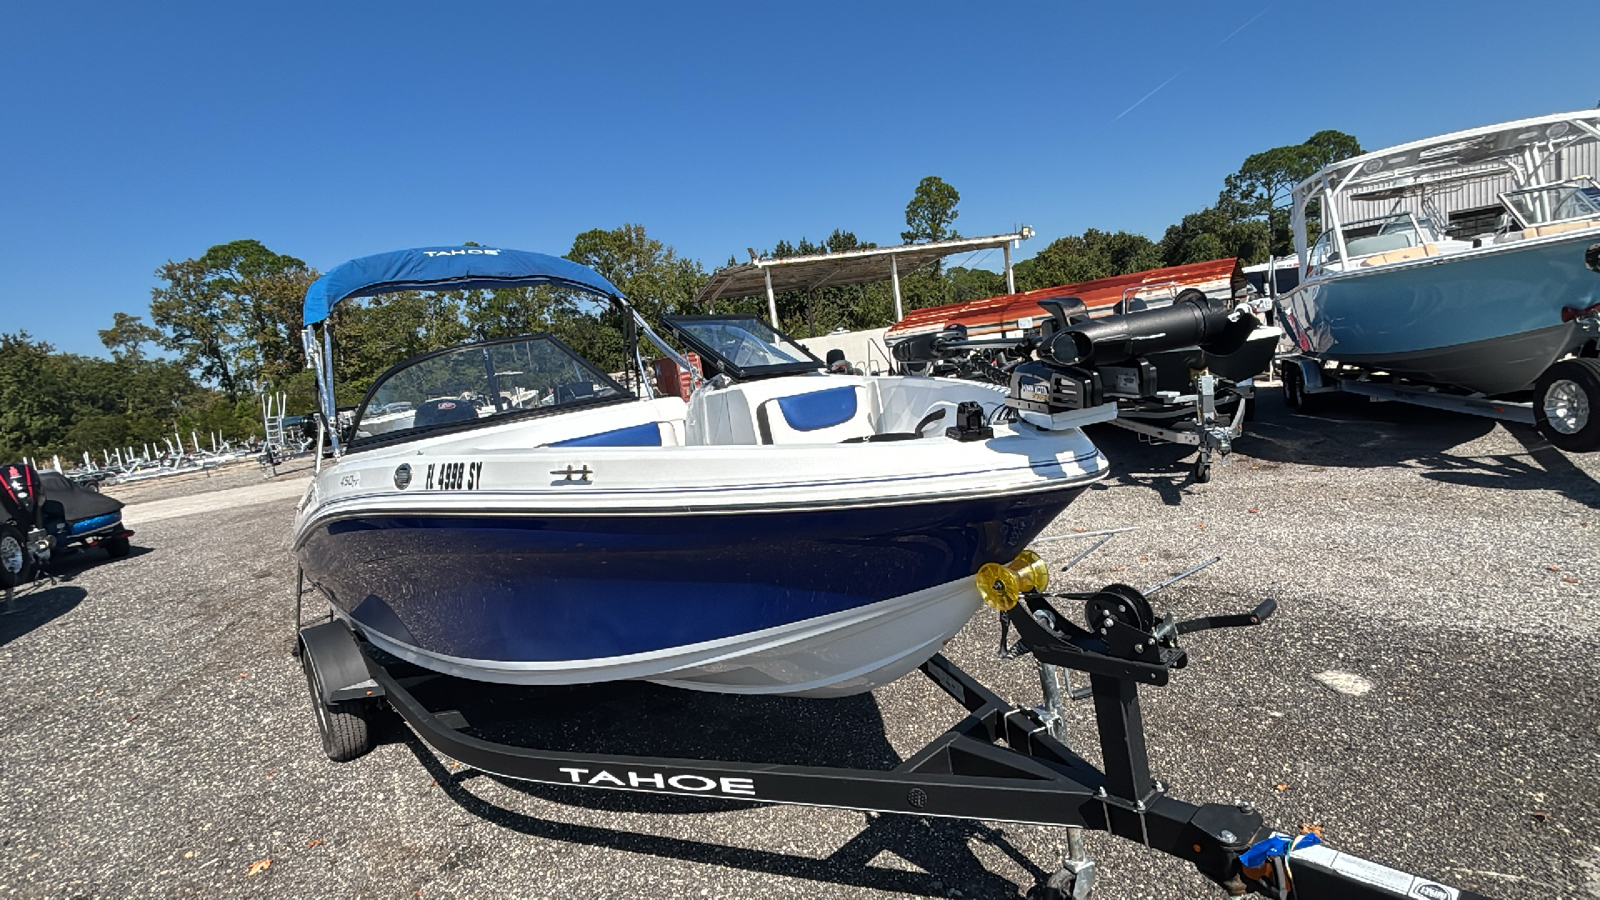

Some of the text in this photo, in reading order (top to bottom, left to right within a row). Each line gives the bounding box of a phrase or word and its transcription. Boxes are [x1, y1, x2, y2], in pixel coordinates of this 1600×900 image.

[423, 249, 501, 257] TAHOE
[425, 462, 483, 490] FL 4998 SY
[559, 767, 756, 795] TAHOE
